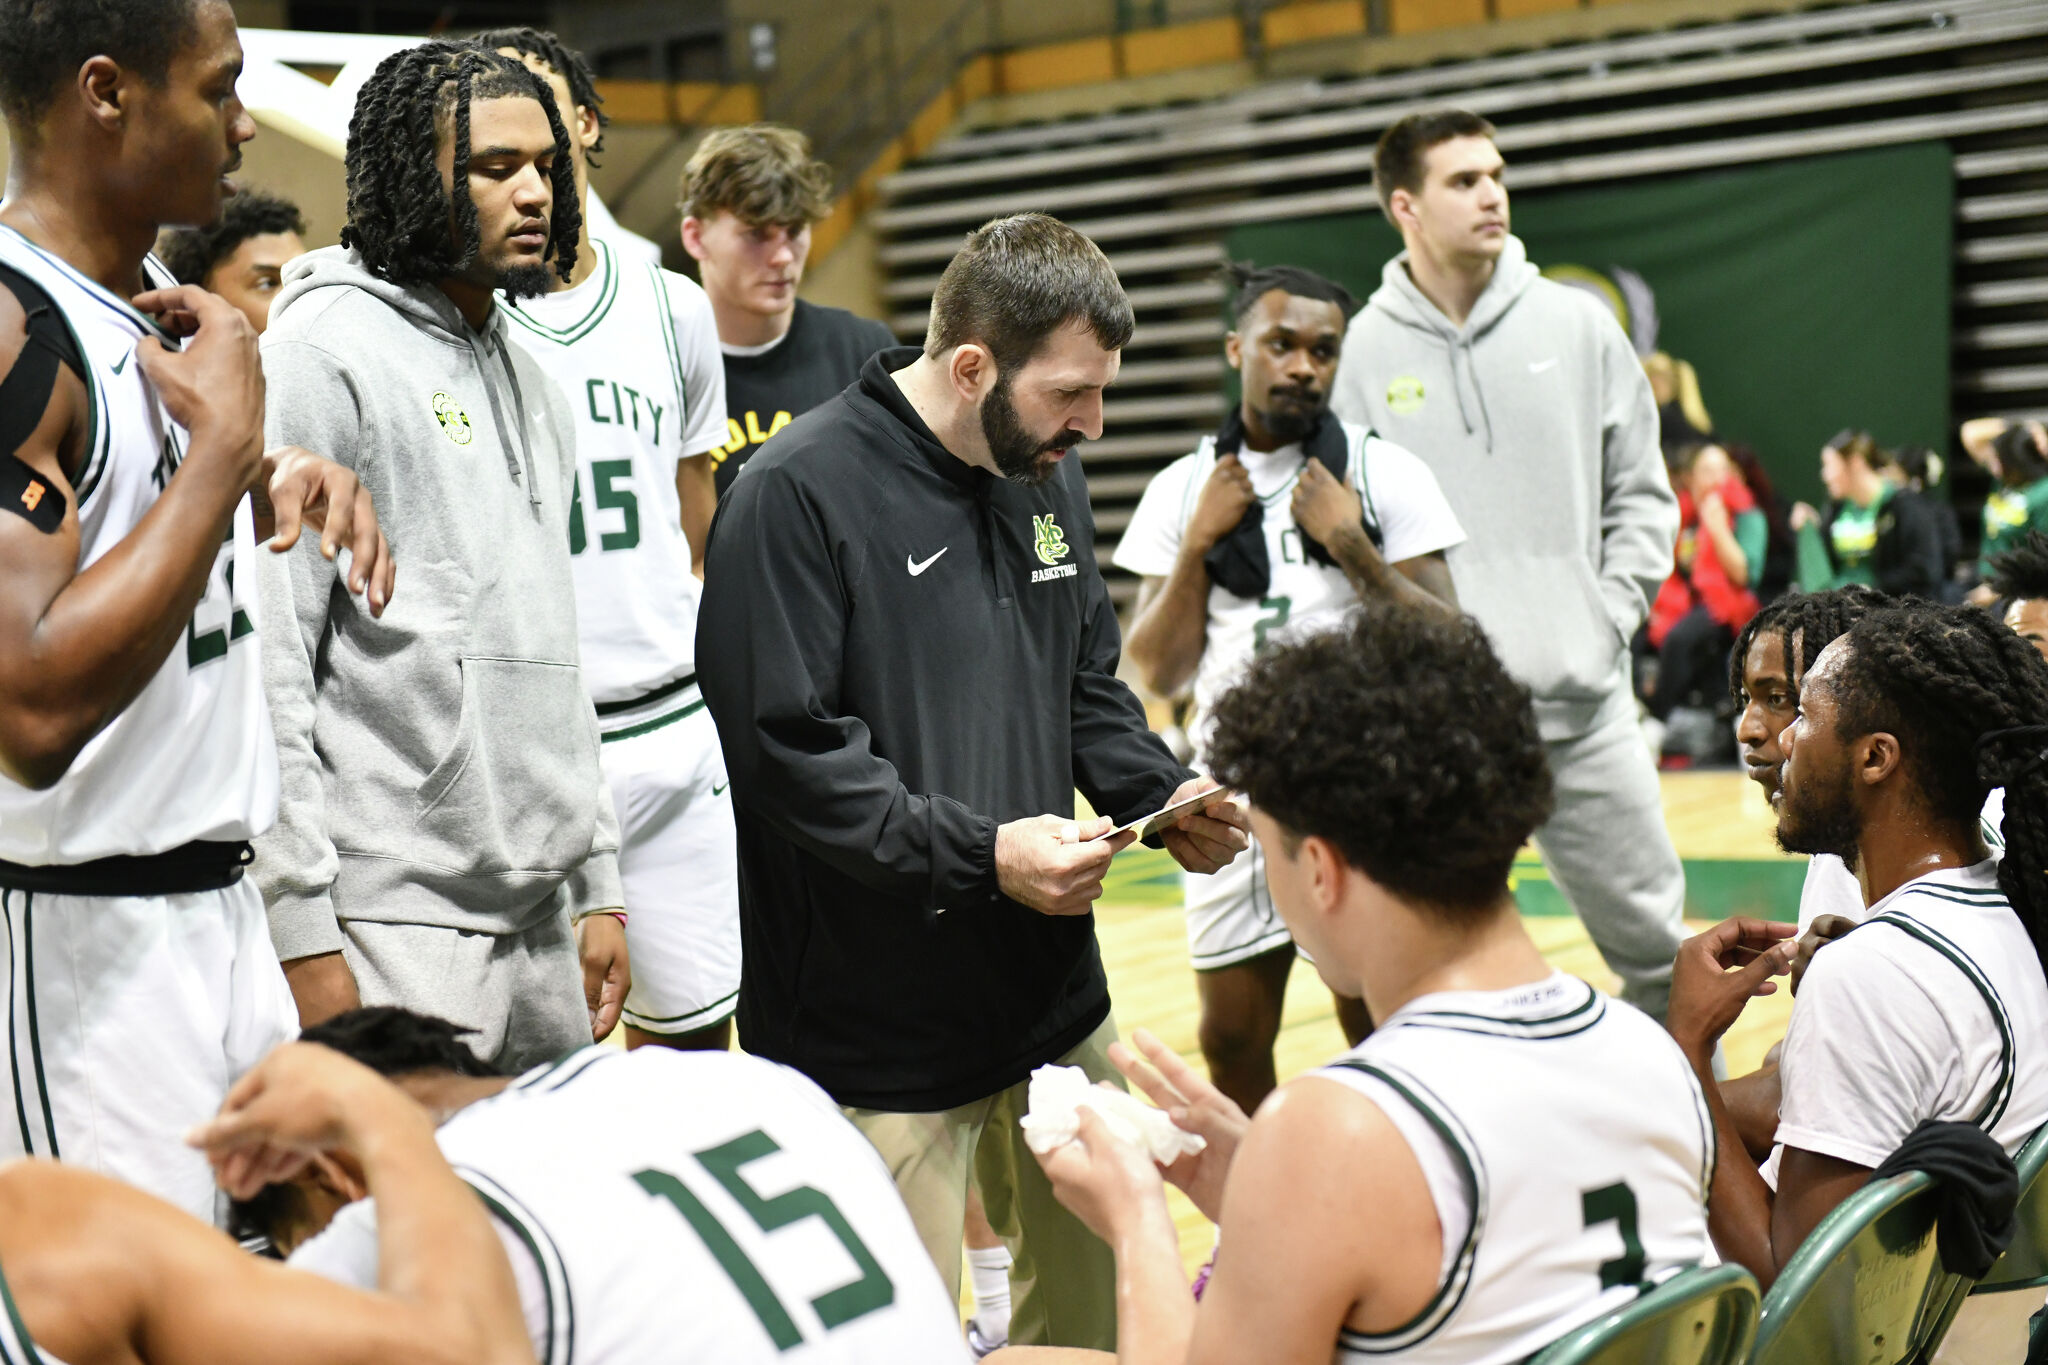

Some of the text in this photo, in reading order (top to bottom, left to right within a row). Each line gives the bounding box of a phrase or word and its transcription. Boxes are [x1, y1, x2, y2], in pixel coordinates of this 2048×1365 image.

[586, 378, 663, 446] CITY
[1031, 563, 1078, 583] BASKETBALL
[1253, 596, 1292, 656] 2
[630, 1128, 895, 1352] 15
